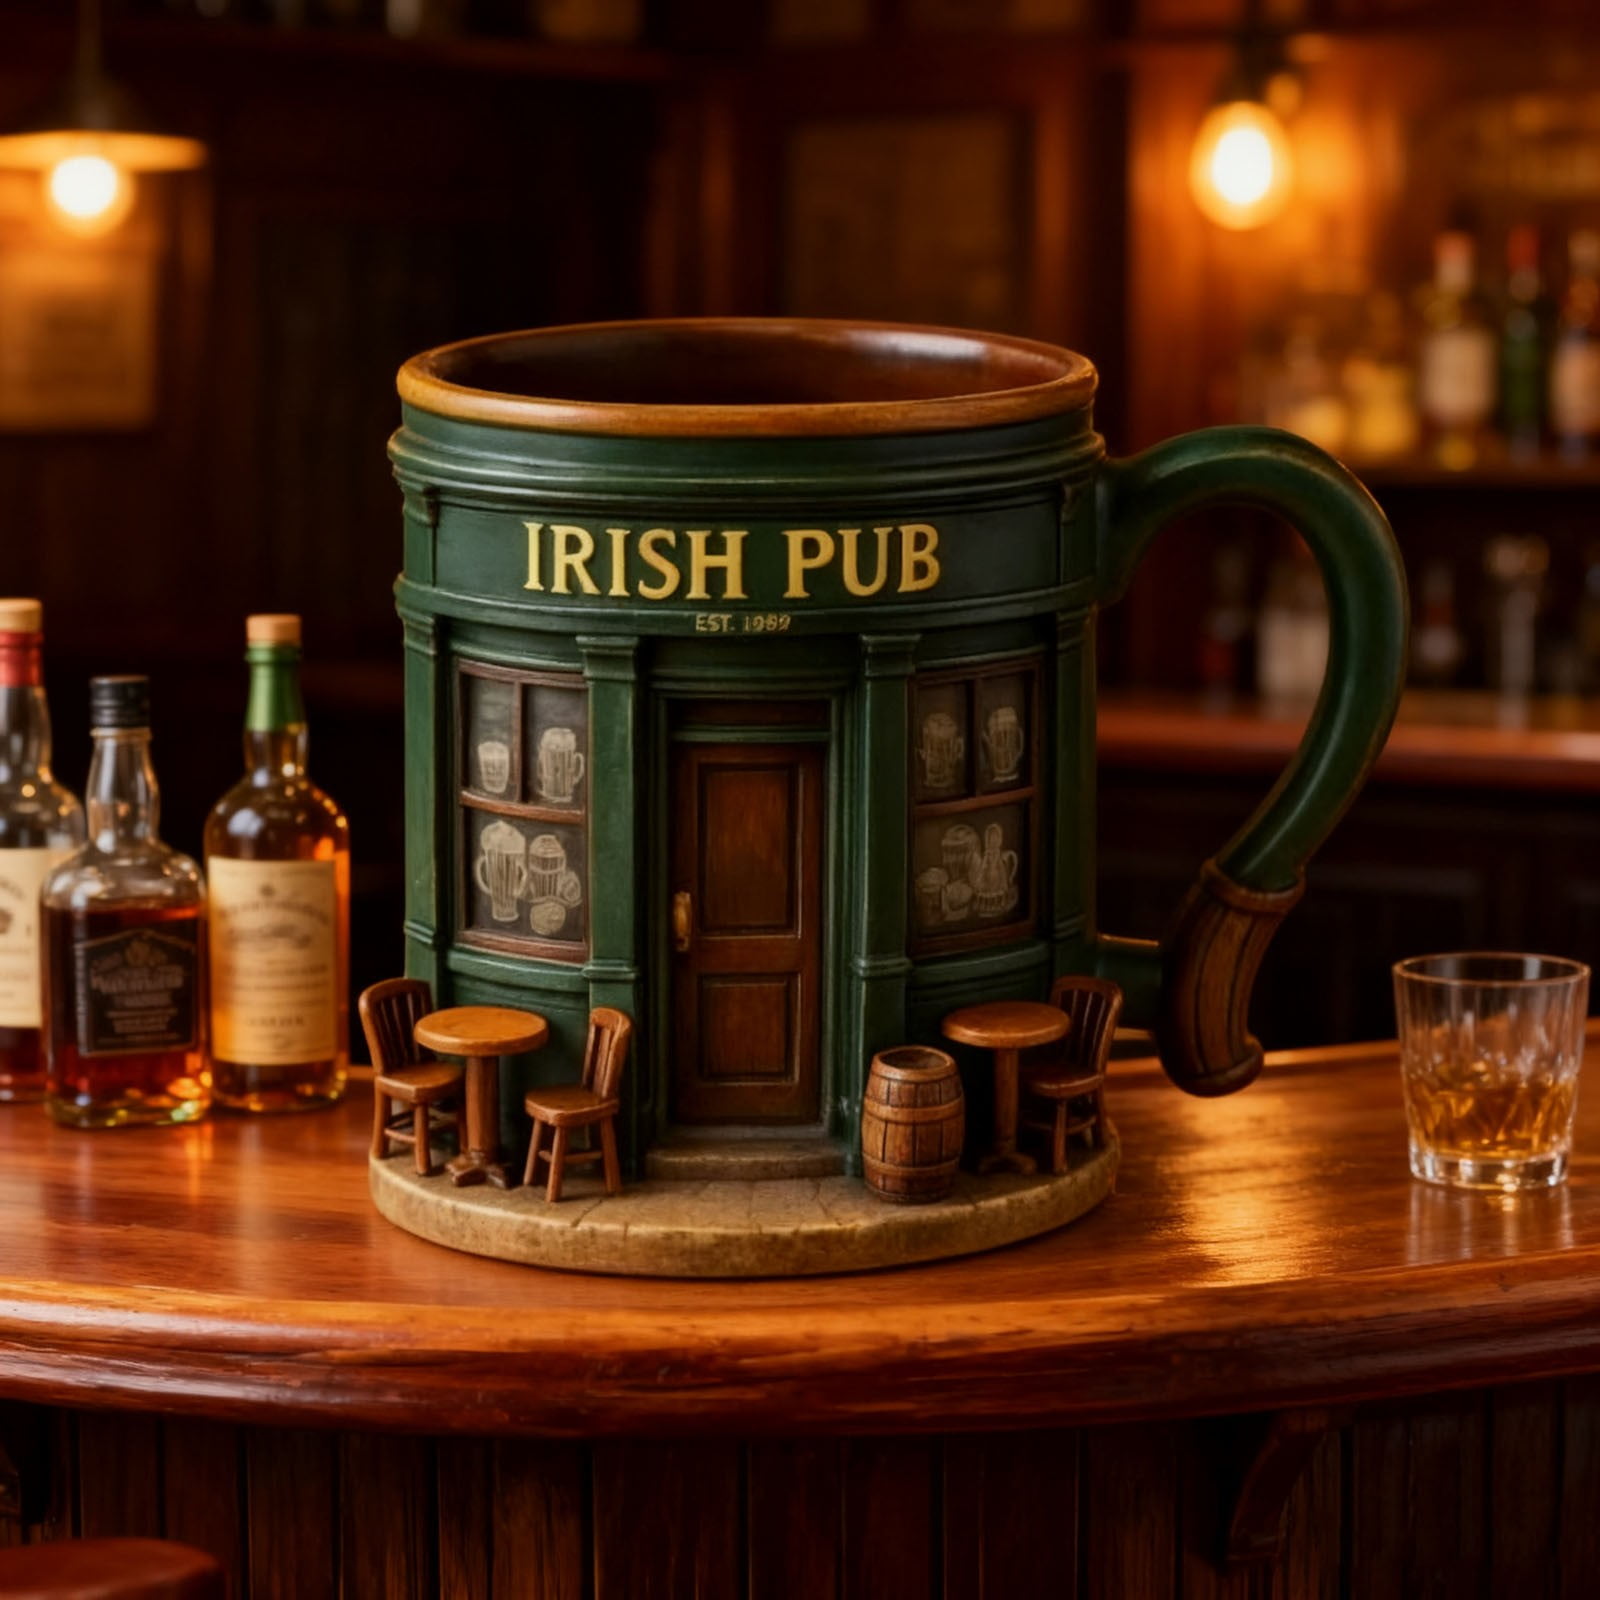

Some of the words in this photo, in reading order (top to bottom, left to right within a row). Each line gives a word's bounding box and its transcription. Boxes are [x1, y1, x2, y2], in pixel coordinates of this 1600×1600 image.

[522, 521, 749, 599] IRISH
[782, 524, 940, 598] PUB
[695, 613, 736, 632] EST.
